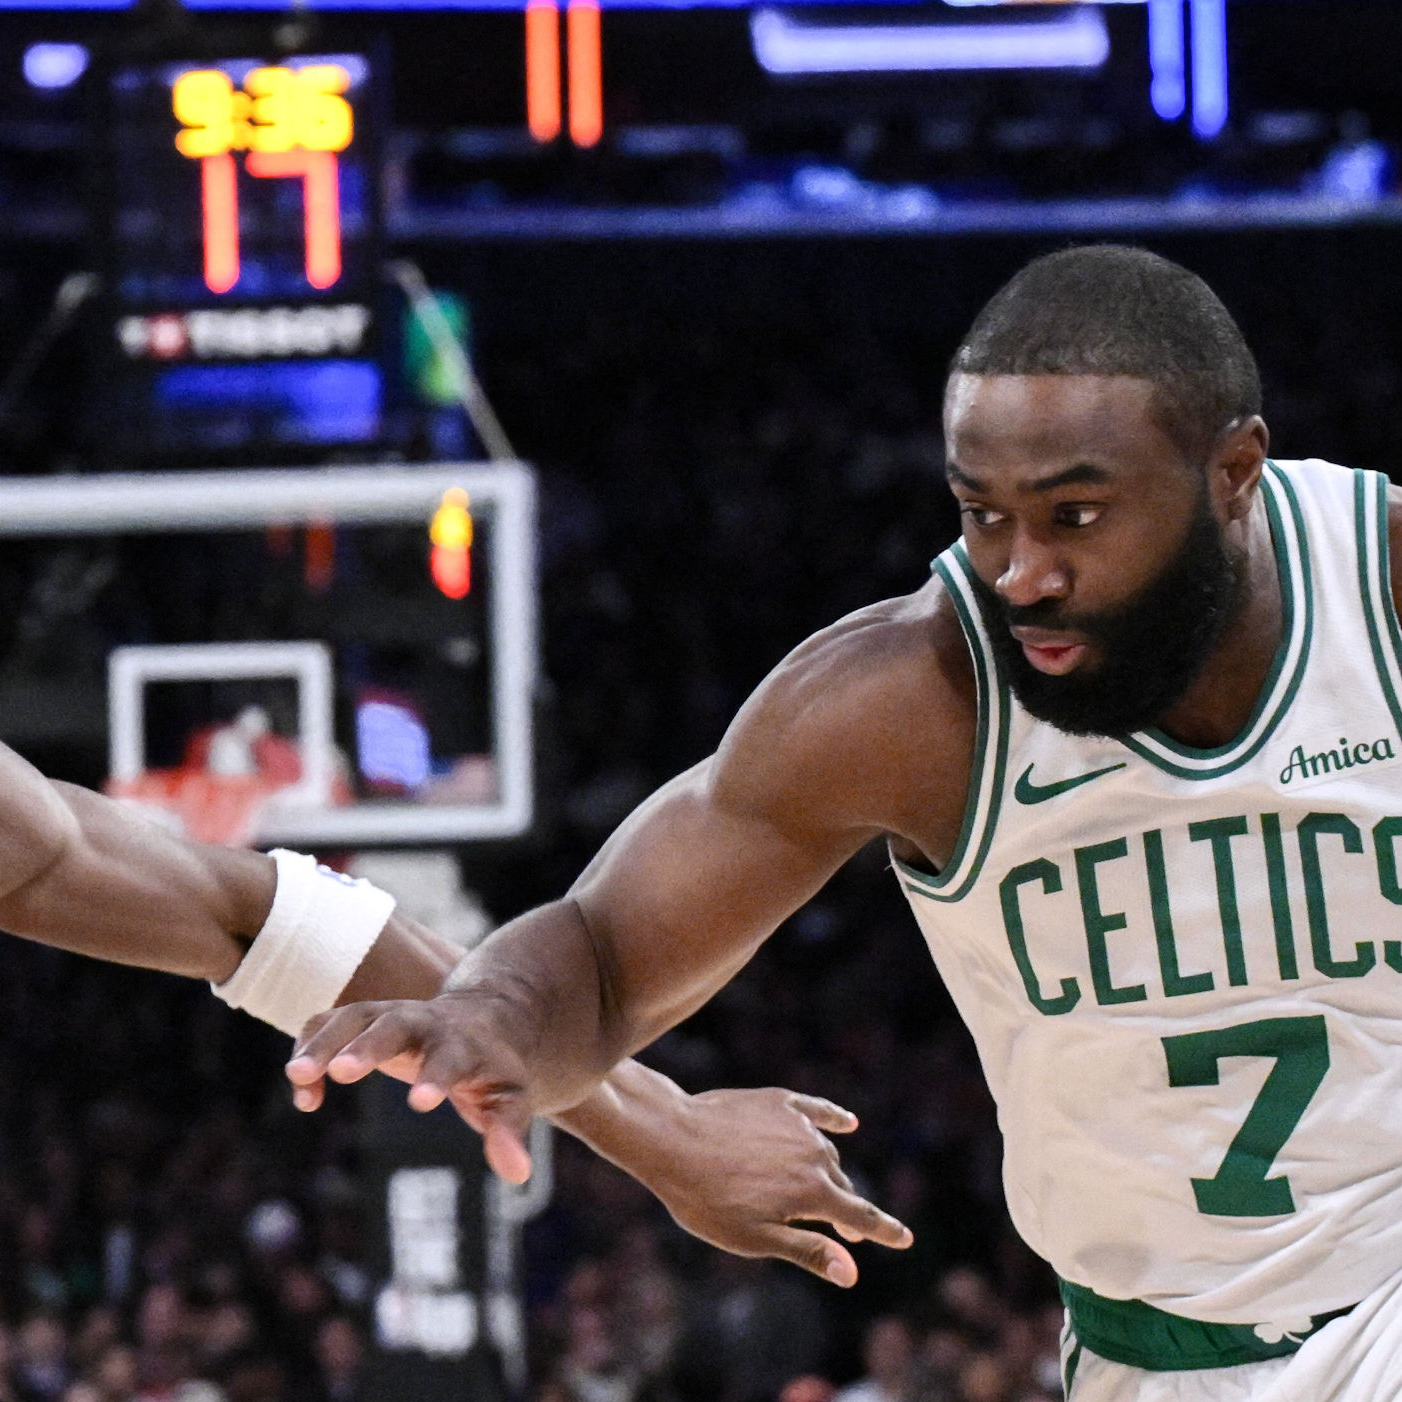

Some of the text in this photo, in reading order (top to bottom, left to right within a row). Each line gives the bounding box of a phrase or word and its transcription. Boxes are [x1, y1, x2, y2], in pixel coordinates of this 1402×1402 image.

[200, 148, 342, 293] 17
[1280, 737, 1395, 785] Amica
[1161, 1014, 1331, 1218] 7
